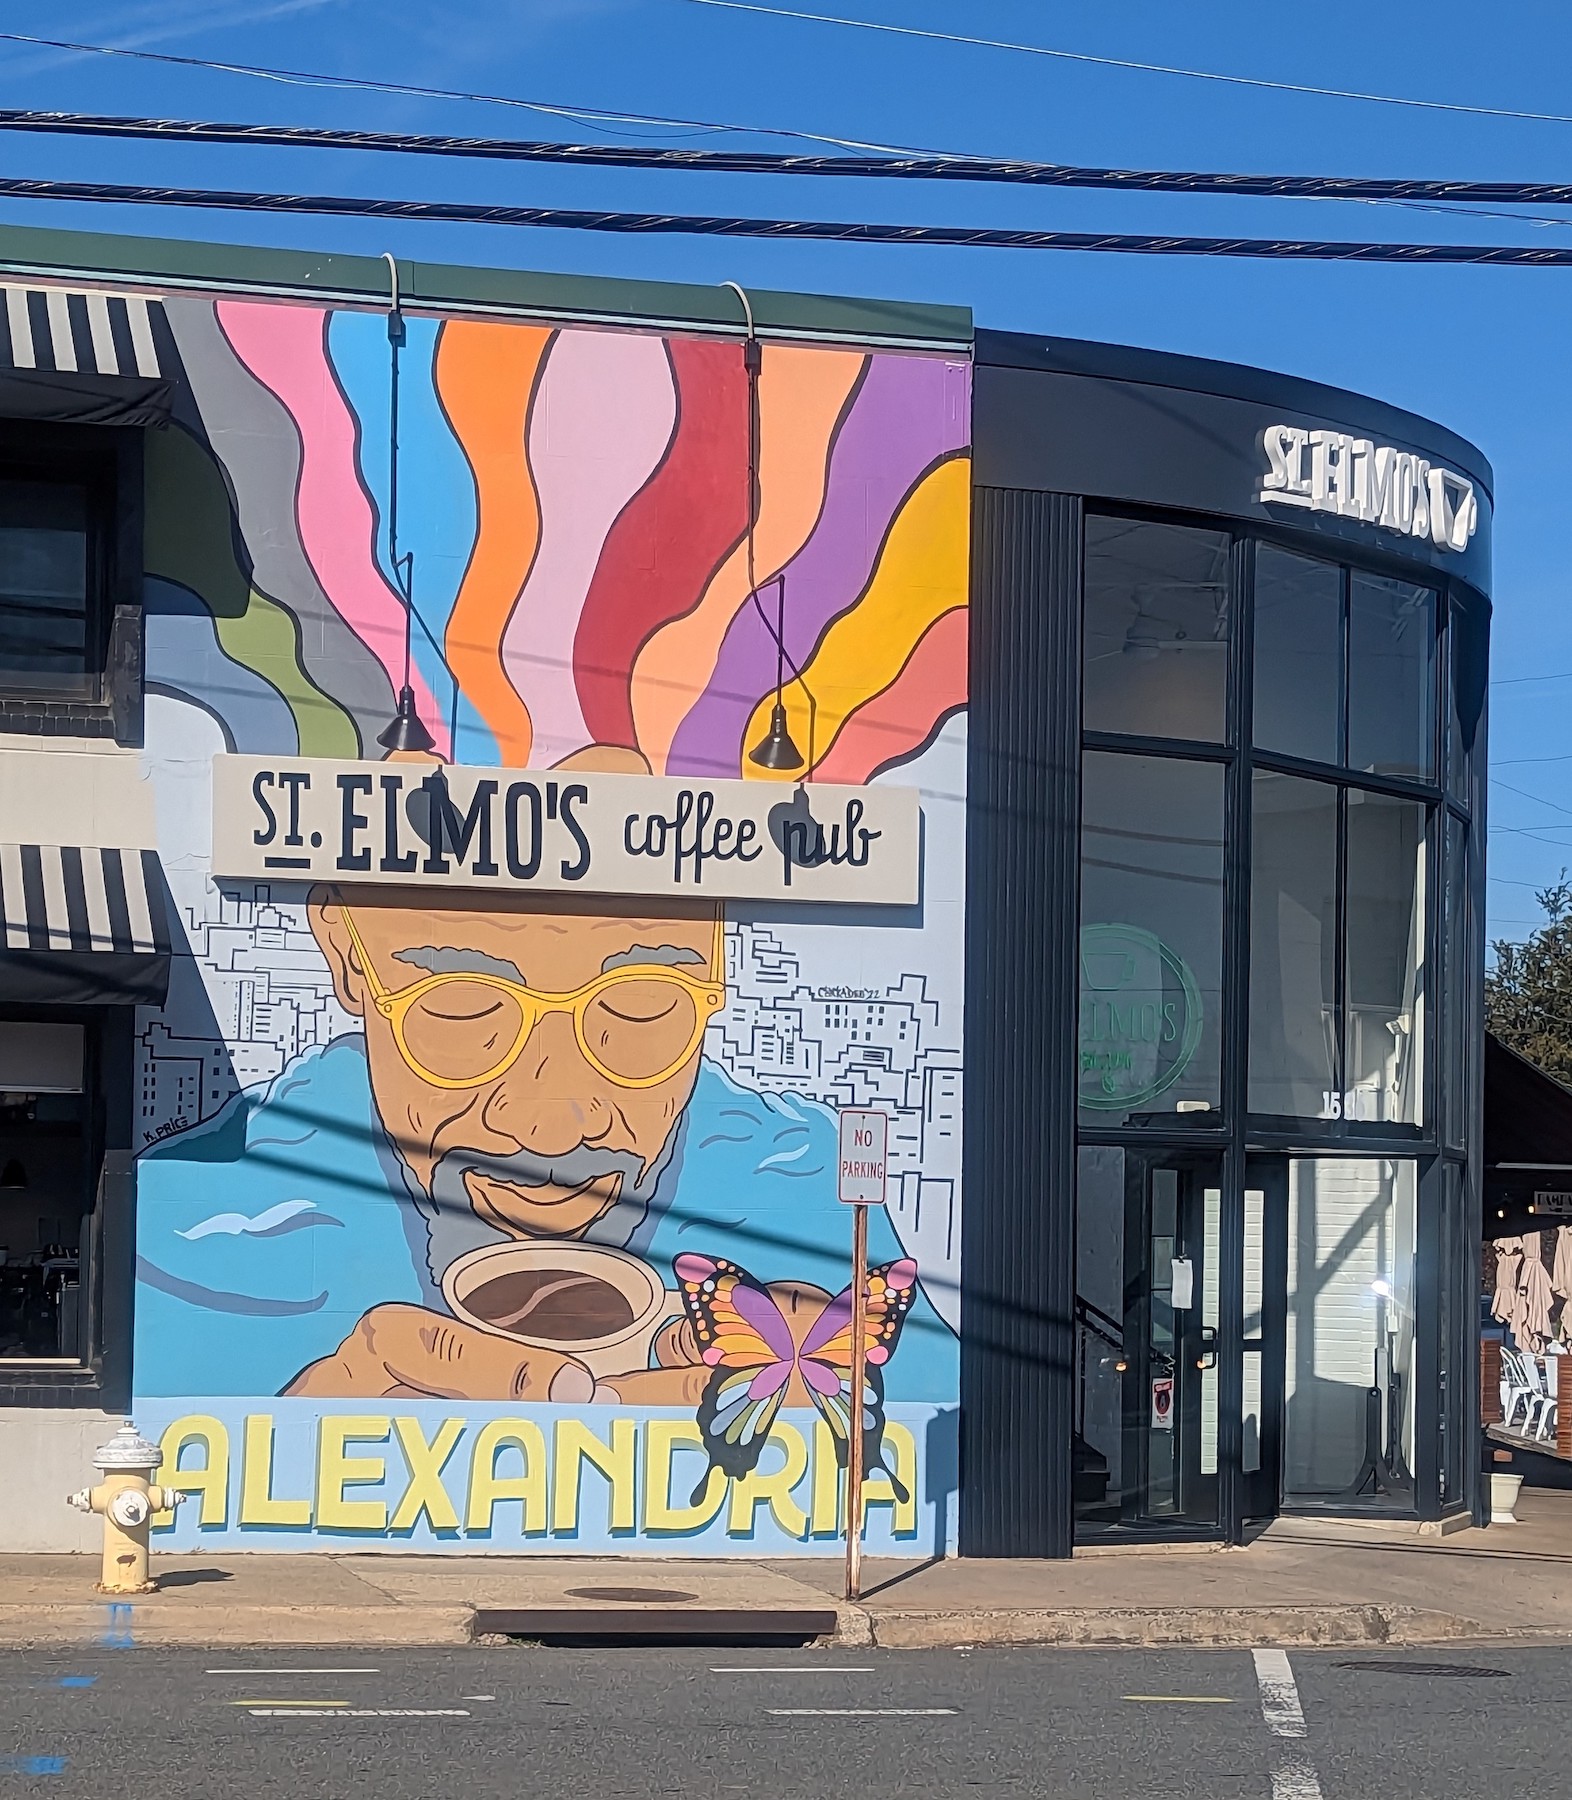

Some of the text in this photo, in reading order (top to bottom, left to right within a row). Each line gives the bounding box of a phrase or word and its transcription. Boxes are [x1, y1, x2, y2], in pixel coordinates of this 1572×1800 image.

[1309, 429, 1431, 540] ELMO'S
[252, 770, 882, 887] ST. ELMO'S coffee pub
[841, 1160, 884, 1180] PARKING
[853, 1129, 873, 1147] NO
[150, 1413, 918, 1541] ALEXANDRIA
